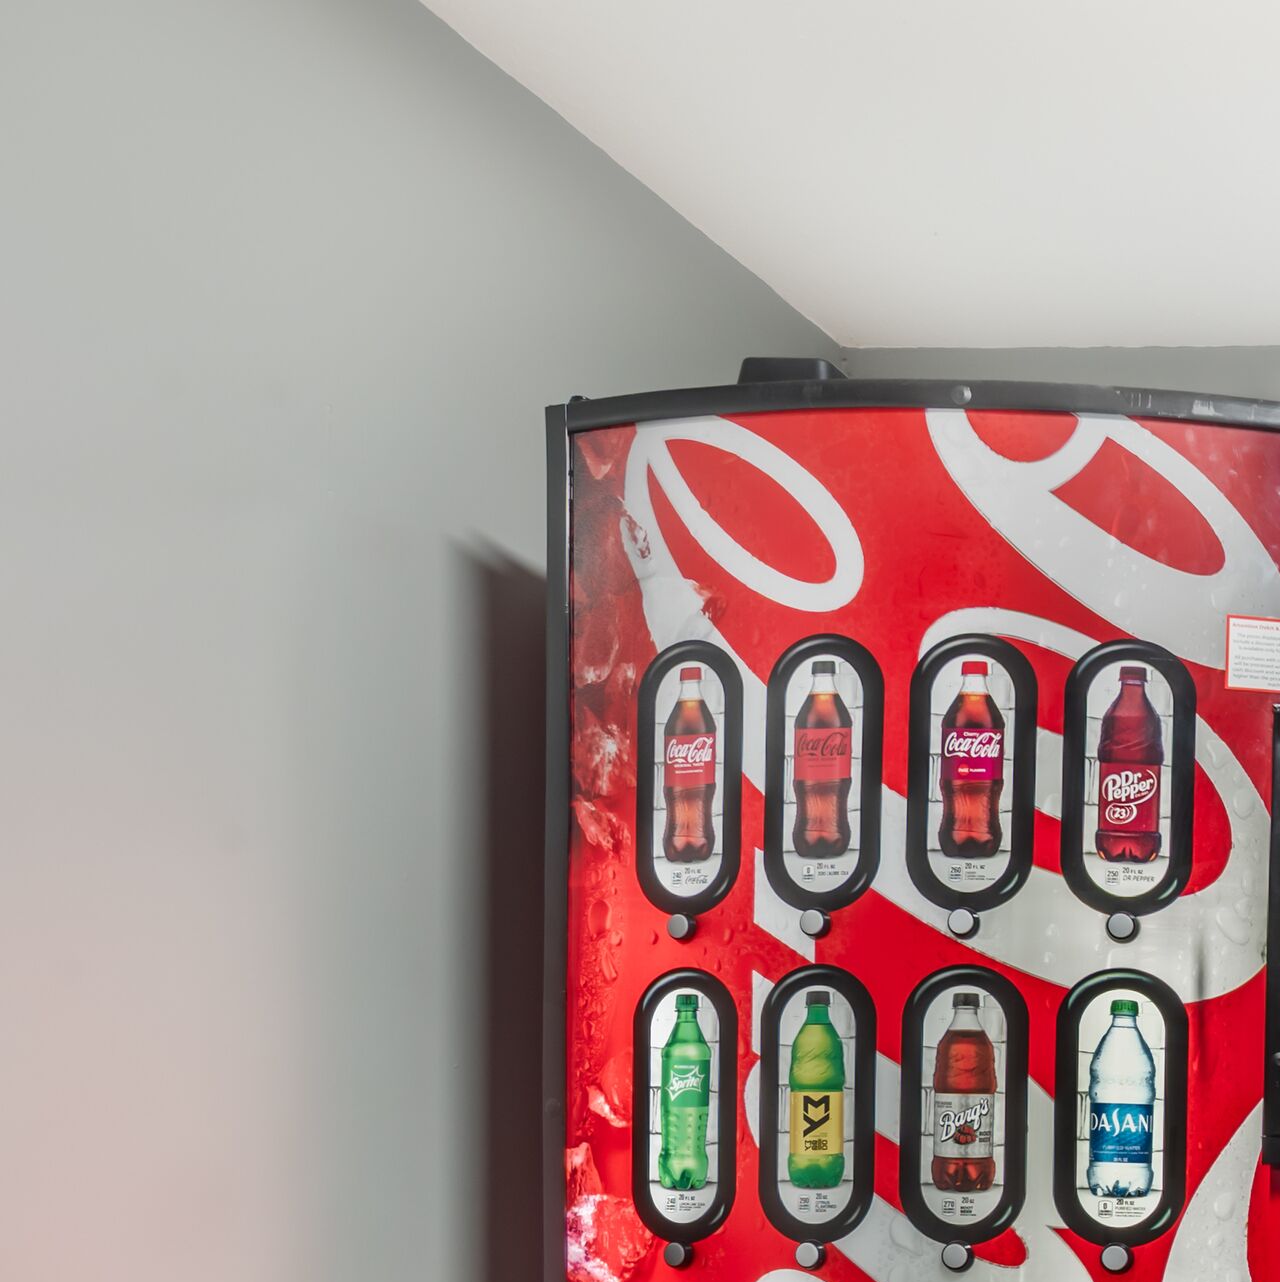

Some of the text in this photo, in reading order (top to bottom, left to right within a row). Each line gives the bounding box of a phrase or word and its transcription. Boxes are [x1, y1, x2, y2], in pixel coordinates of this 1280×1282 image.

[666, 737, 713, 764] Coca-Cola
[797, 732, 848, 757] Coca-Cola
[944, 732, 1001, 758] Coca-Cola
[1102, 774, 1154, 802] Pepper
[1120, 771, 1142, 787] Dr
[1114, 807, 1127, 819] 23
[670, 1076, 701, 1092] Sprite
[939, 1097, 989, 1142] Barq's
[1090, 1107, 1153, 1137] DASANI
